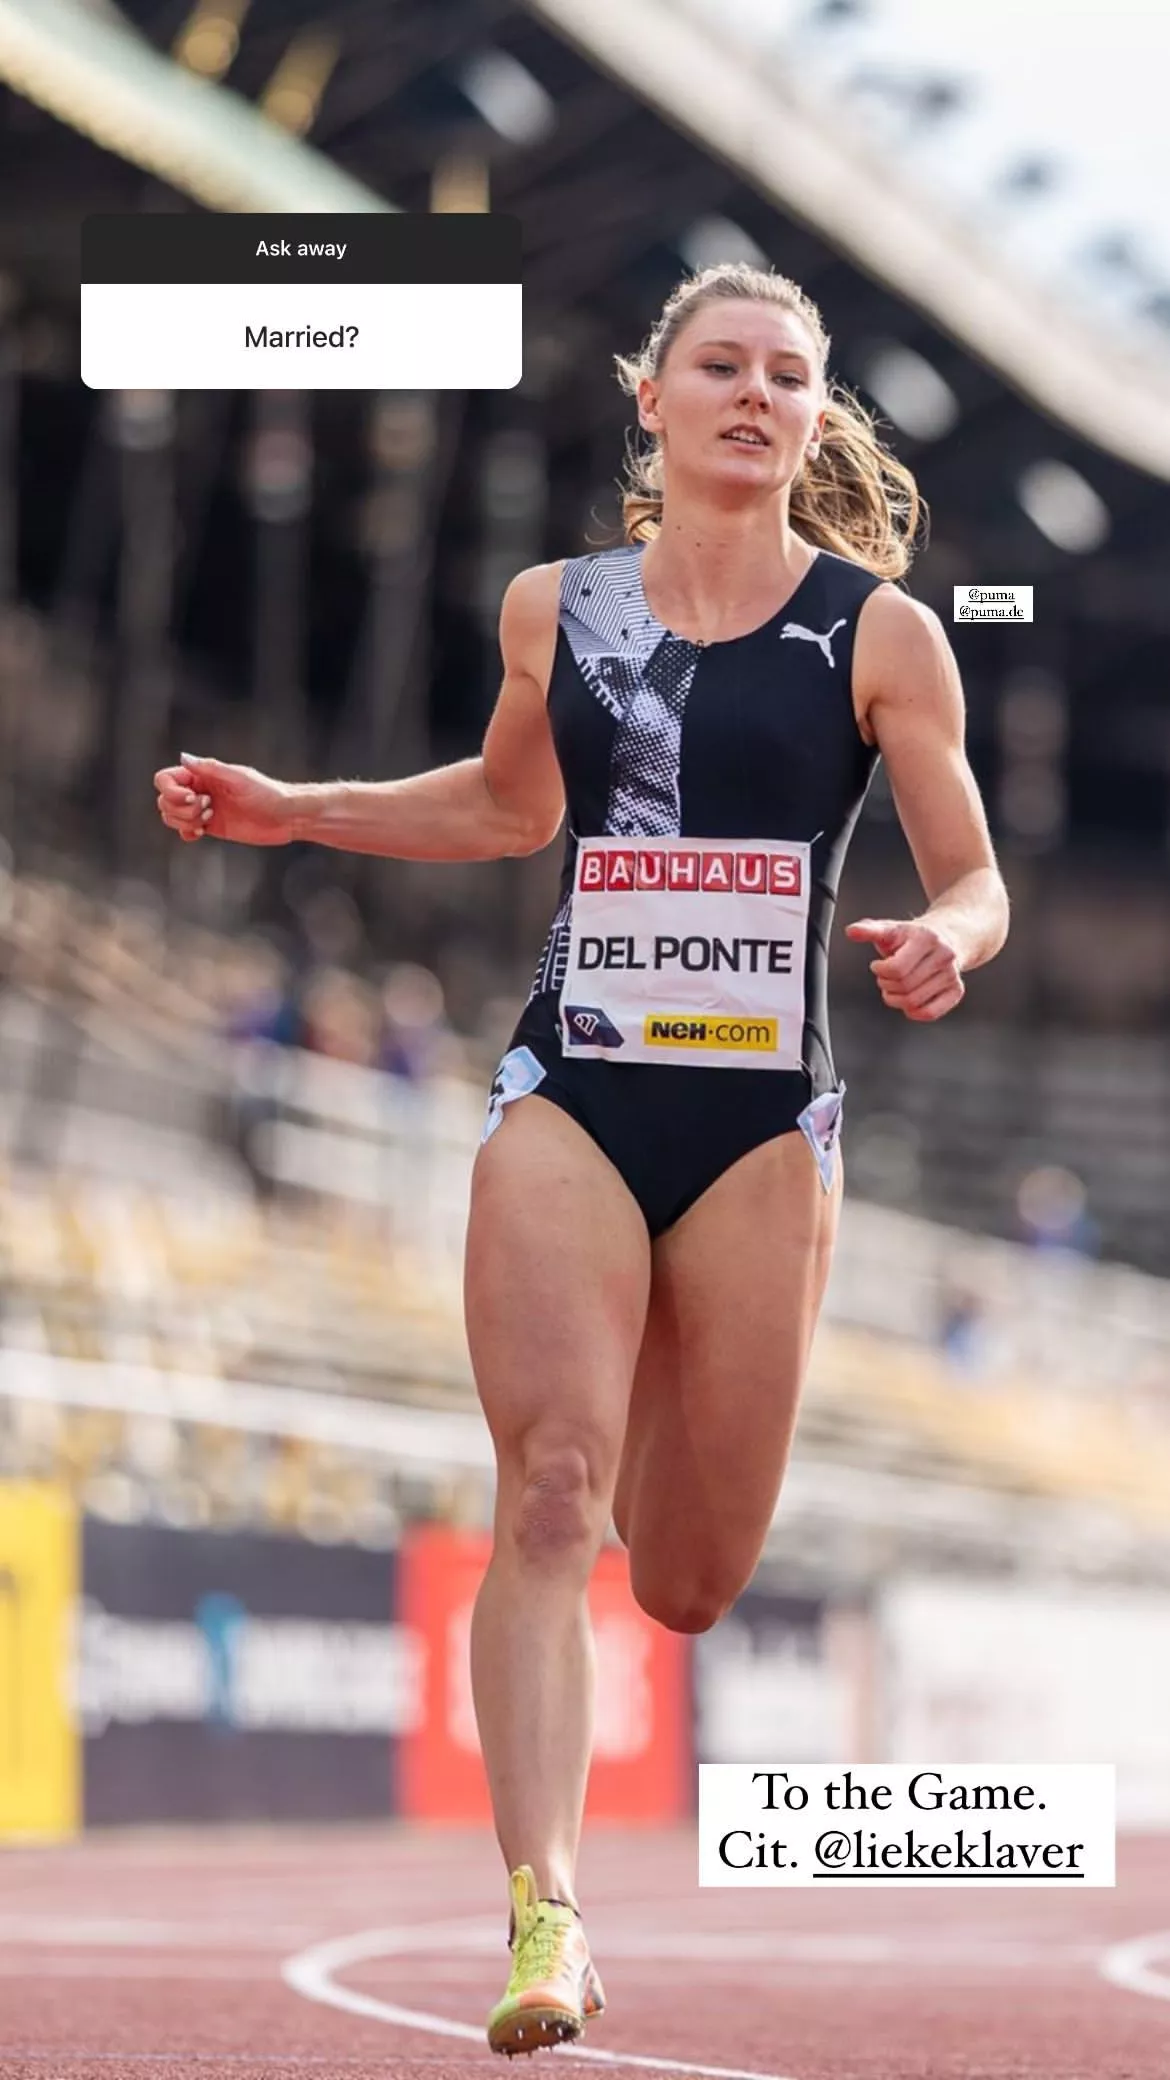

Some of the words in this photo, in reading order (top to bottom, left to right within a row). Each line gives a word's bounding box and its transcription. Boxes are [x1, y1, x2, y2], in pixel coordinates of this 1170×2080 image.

[582, 854, 797, 889] BAUHAUS
[577, 936, 647, 970] DEL
[654, 936, 793, 974] PONTE
